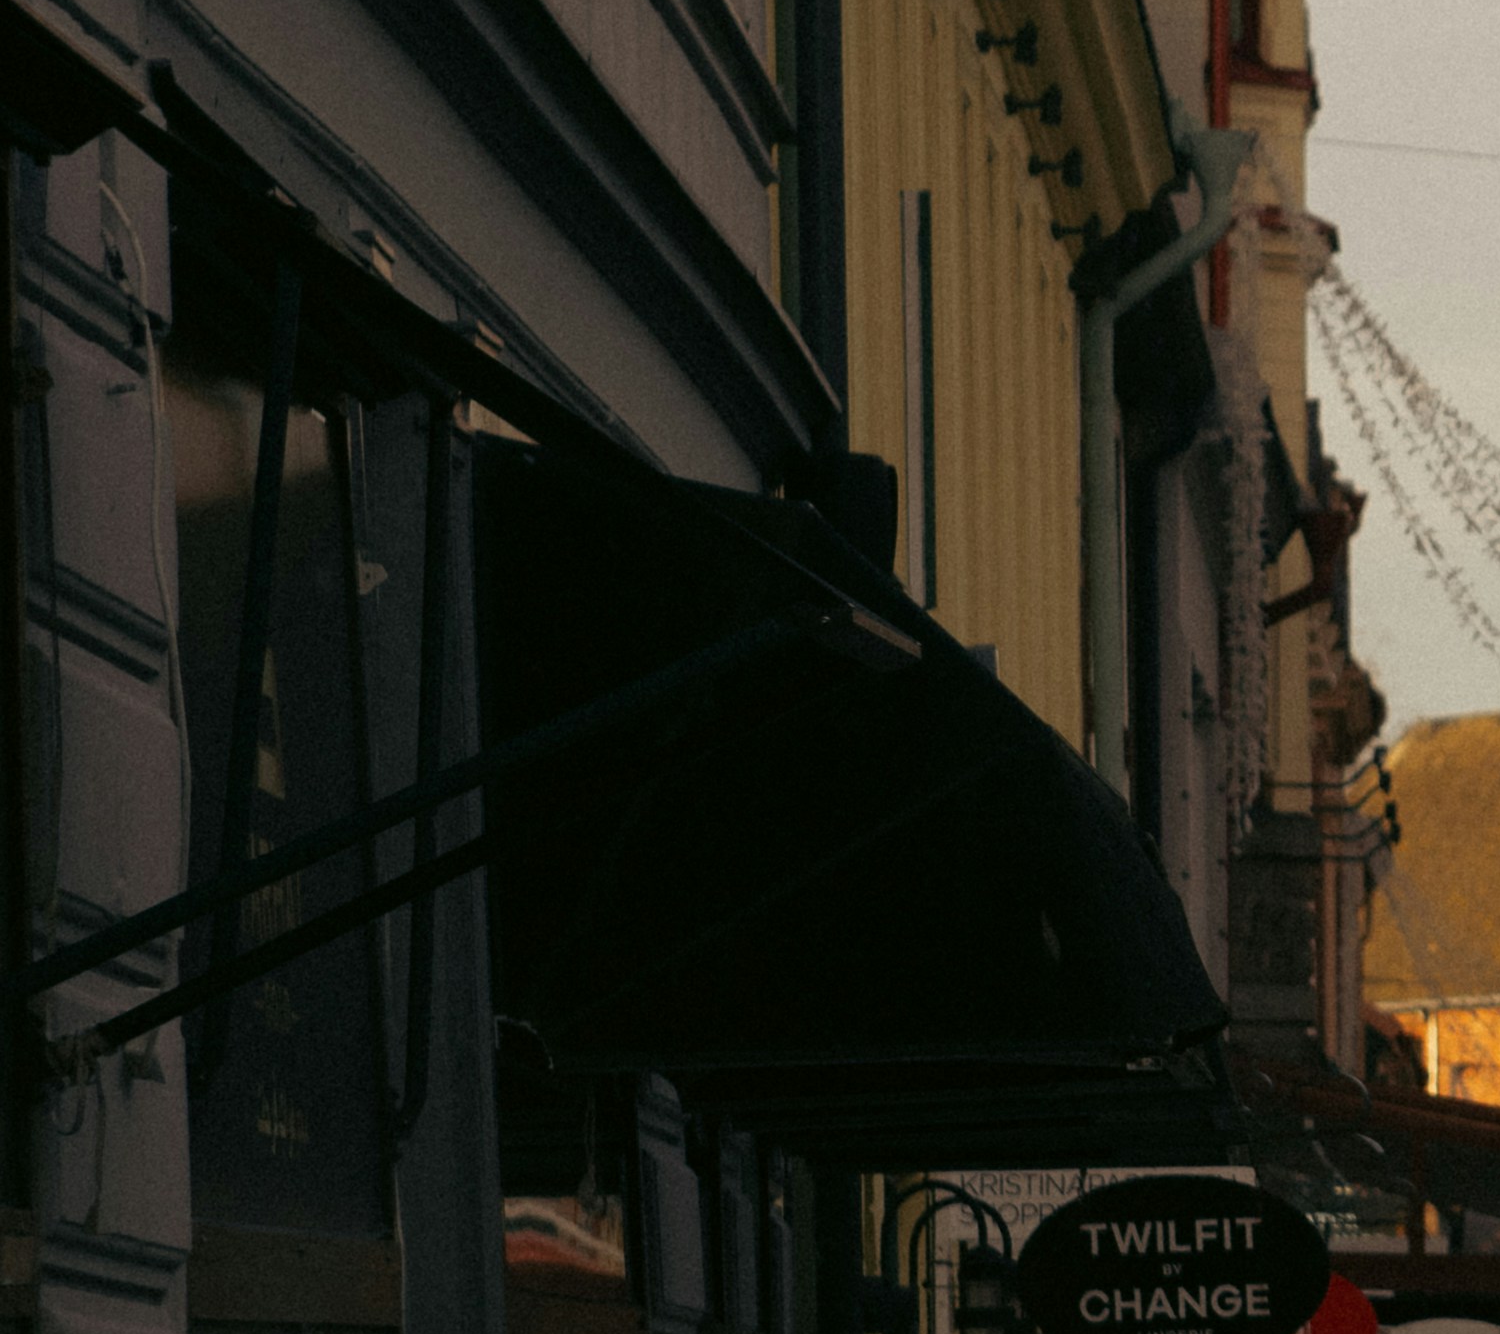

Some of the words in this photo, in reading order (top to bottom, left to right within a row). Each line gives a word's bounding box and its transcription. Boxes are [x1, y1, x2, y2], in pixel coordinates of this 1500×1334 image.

[1079, 1216, 1263, 1257] TWILFIT
[1161, 1263, 1183, 1279] BY
[1078, 1282, 1272, 1324] CHANGE
